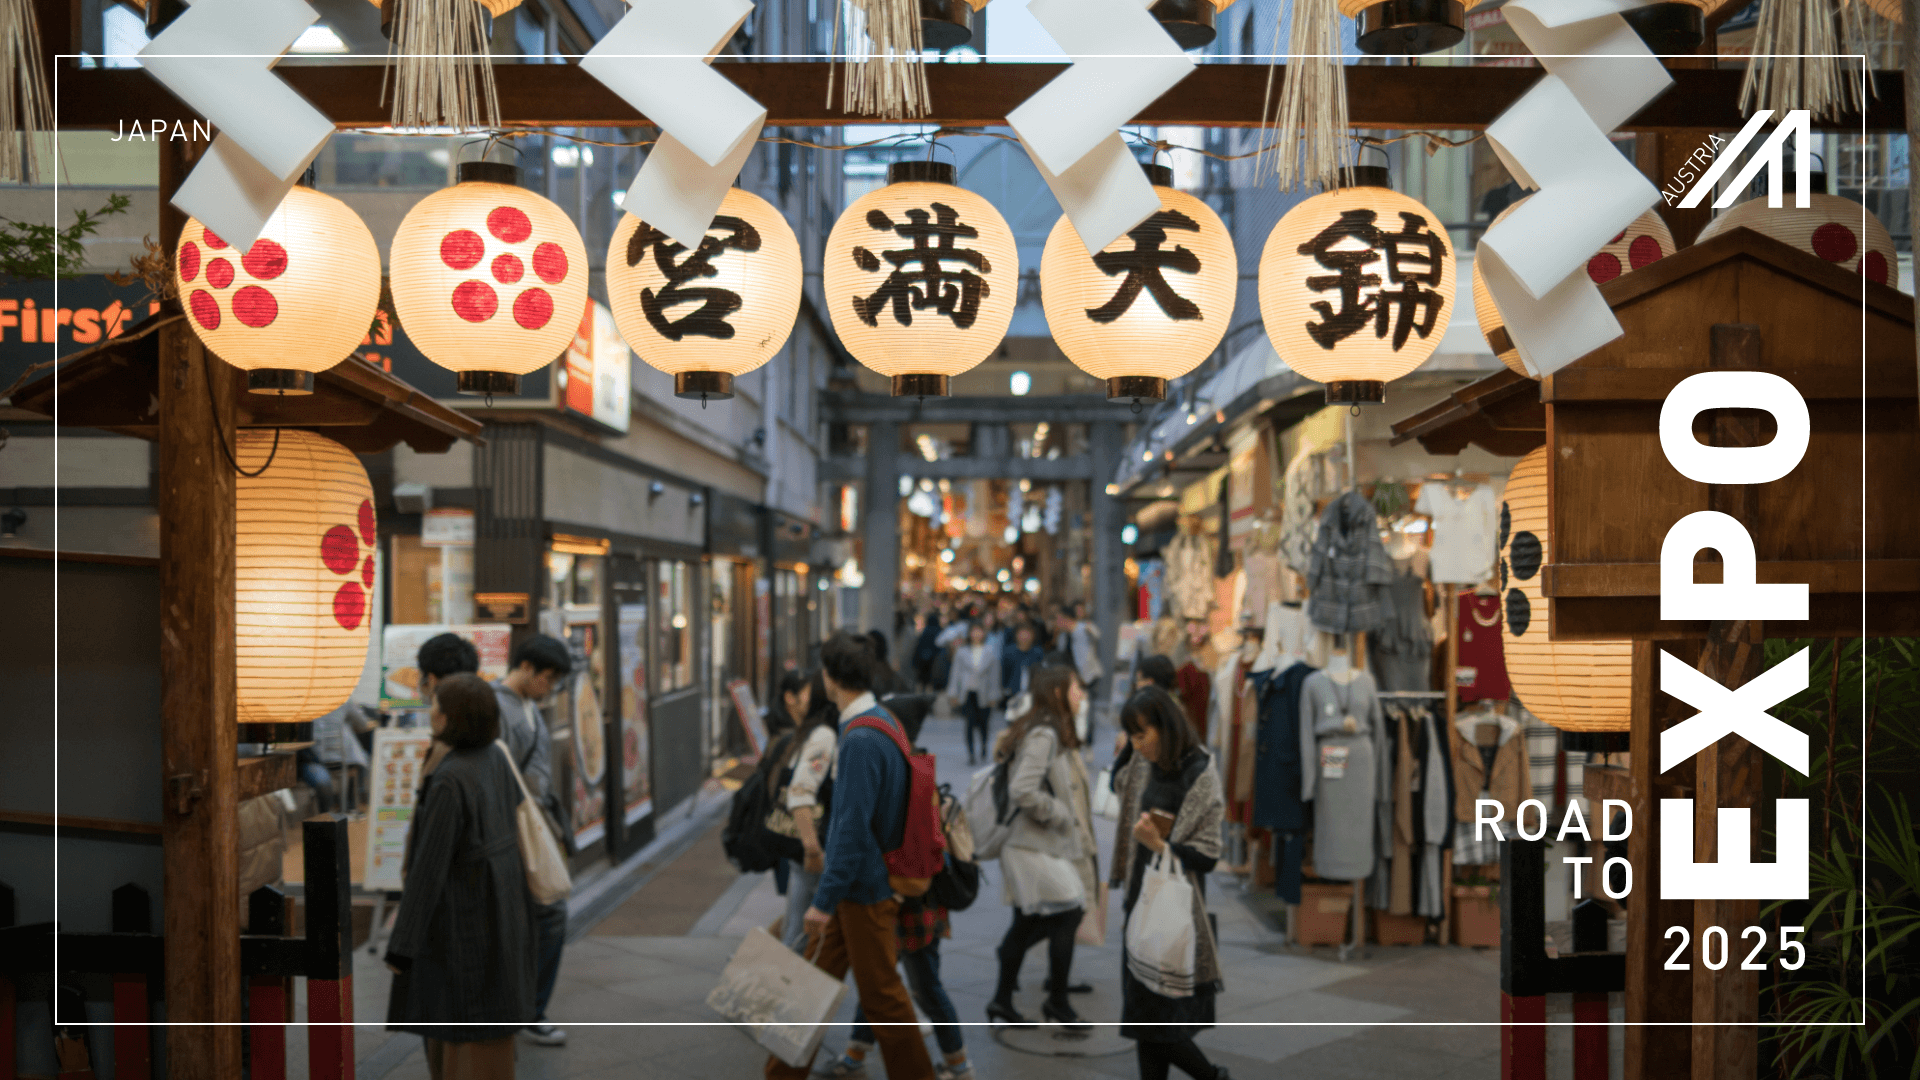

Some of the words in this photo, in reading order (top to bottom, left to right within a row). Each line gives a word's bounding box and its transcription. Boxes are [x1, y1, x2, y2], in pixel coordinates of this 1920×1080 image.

[0, 298, 133, 344] First
[852, 202, 992, 330] 満
[1085, 209, 1204, 325] 天
[1297, 208, 1448, 353] 錦
